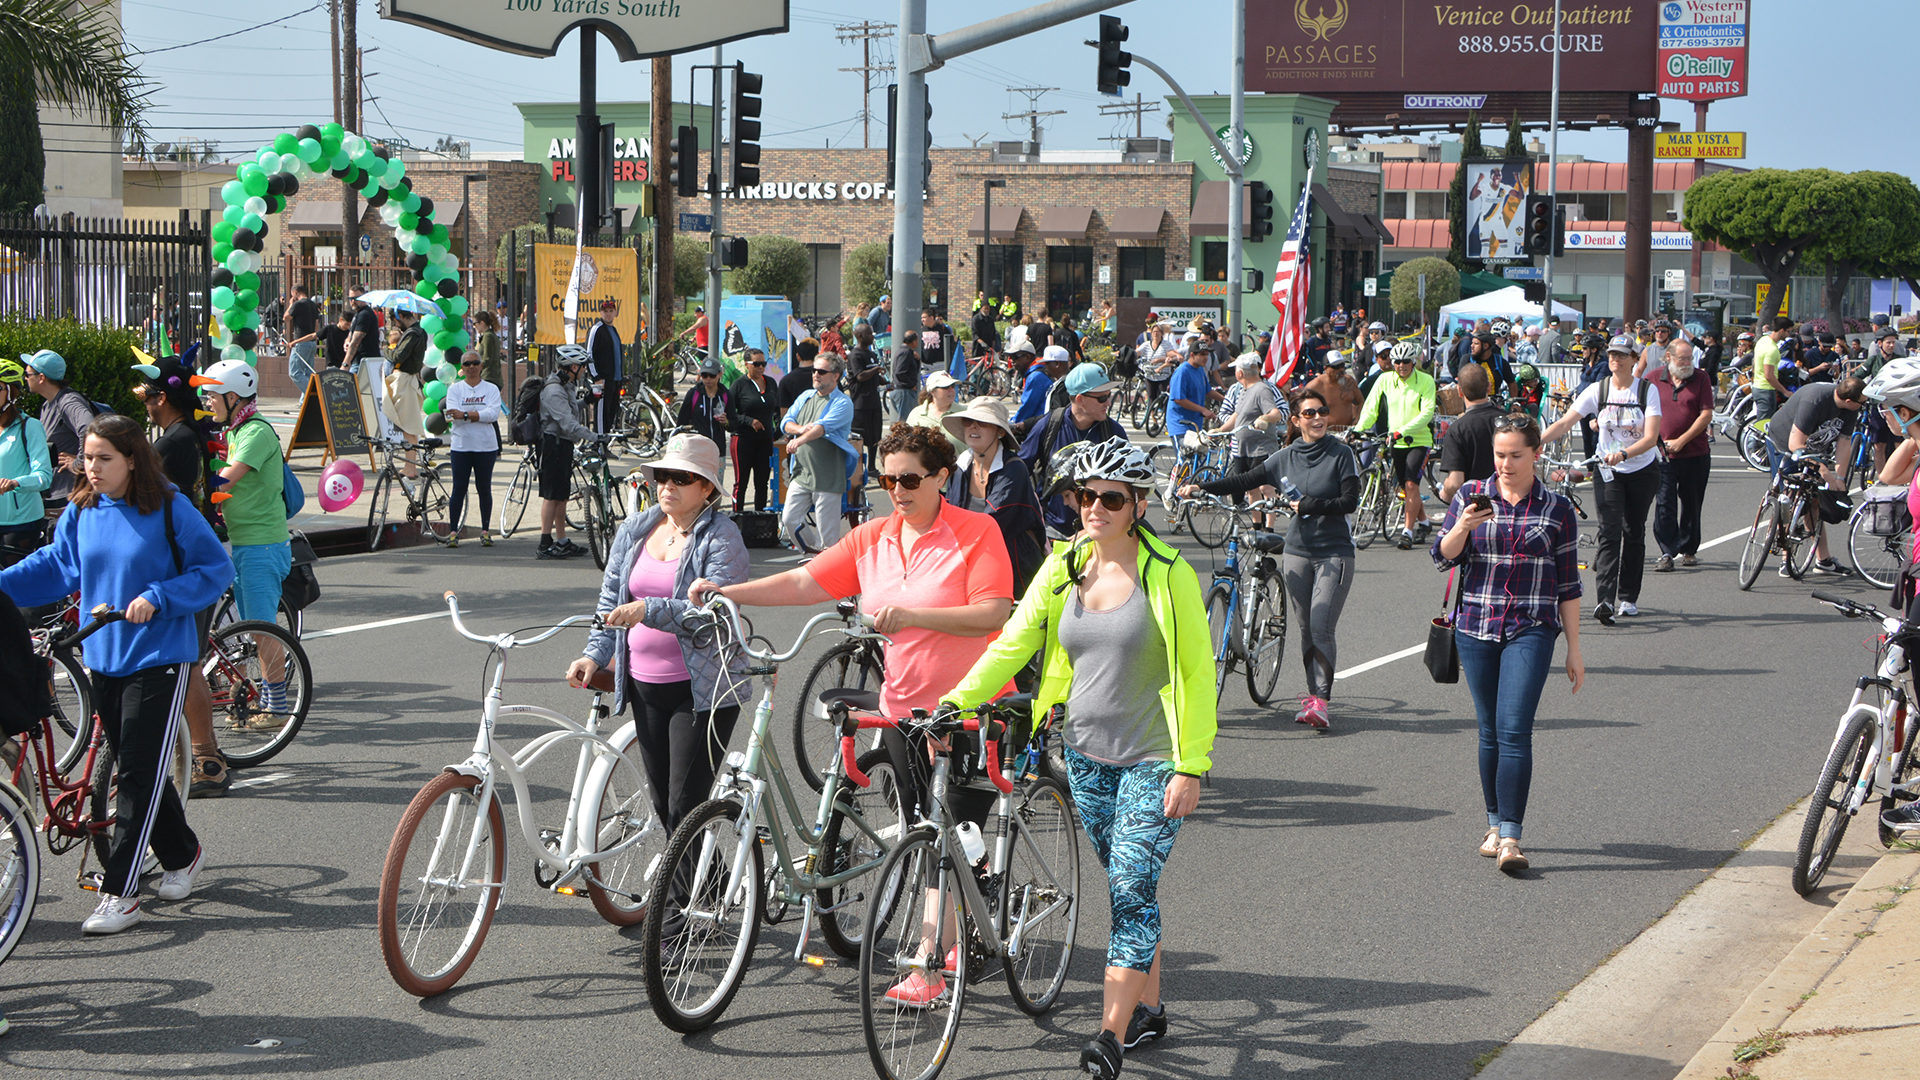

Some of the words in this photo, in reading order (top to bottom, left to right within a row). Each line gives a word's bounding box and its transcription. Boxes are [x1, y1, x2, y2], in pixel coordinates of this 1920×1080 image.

[617, 0, 681, 18] South
[1687, 0, 1743, 11] Western
[1434, 5, 1504, 26] Venice
[1511, 4, 1633, 31] Outpatient
[1694, 12, 1737, 24] Dental
[1661, 27, 1672, 37] &
[1674, 25, 1743, 37] Orthodontics
[1458, 34, 1604, 53] 888.955.CURE
[1661, 38, 1741, 48] 877-699-3797
[1265, 45, 1377, 64] PASSAGES
[1668, 54, 1733, 77] O'Reilly
[1265, 71, 1319, 79] ADDICTION
[1351, 70, 1375, 78] HERE
[1661, 82, 1694, 94] AUTO
[1698, 81, 1740, 93] PARTS
[1407, 96, 1482, 107] OUTFRONT
[1637, 117, 1656, 127] 1047
[1668, 134, 1692, 144] MAR
[1697, 134, 1730, 144] VISTA
[1658, 147, 1691, 156] RANCH
[1697, 146, 1739, 156] MARKET
[552, 160, 648, 181] FLERS
[1584, 235, 1616, 246] Dental
[1193, 284, 1228, 296] 12404
